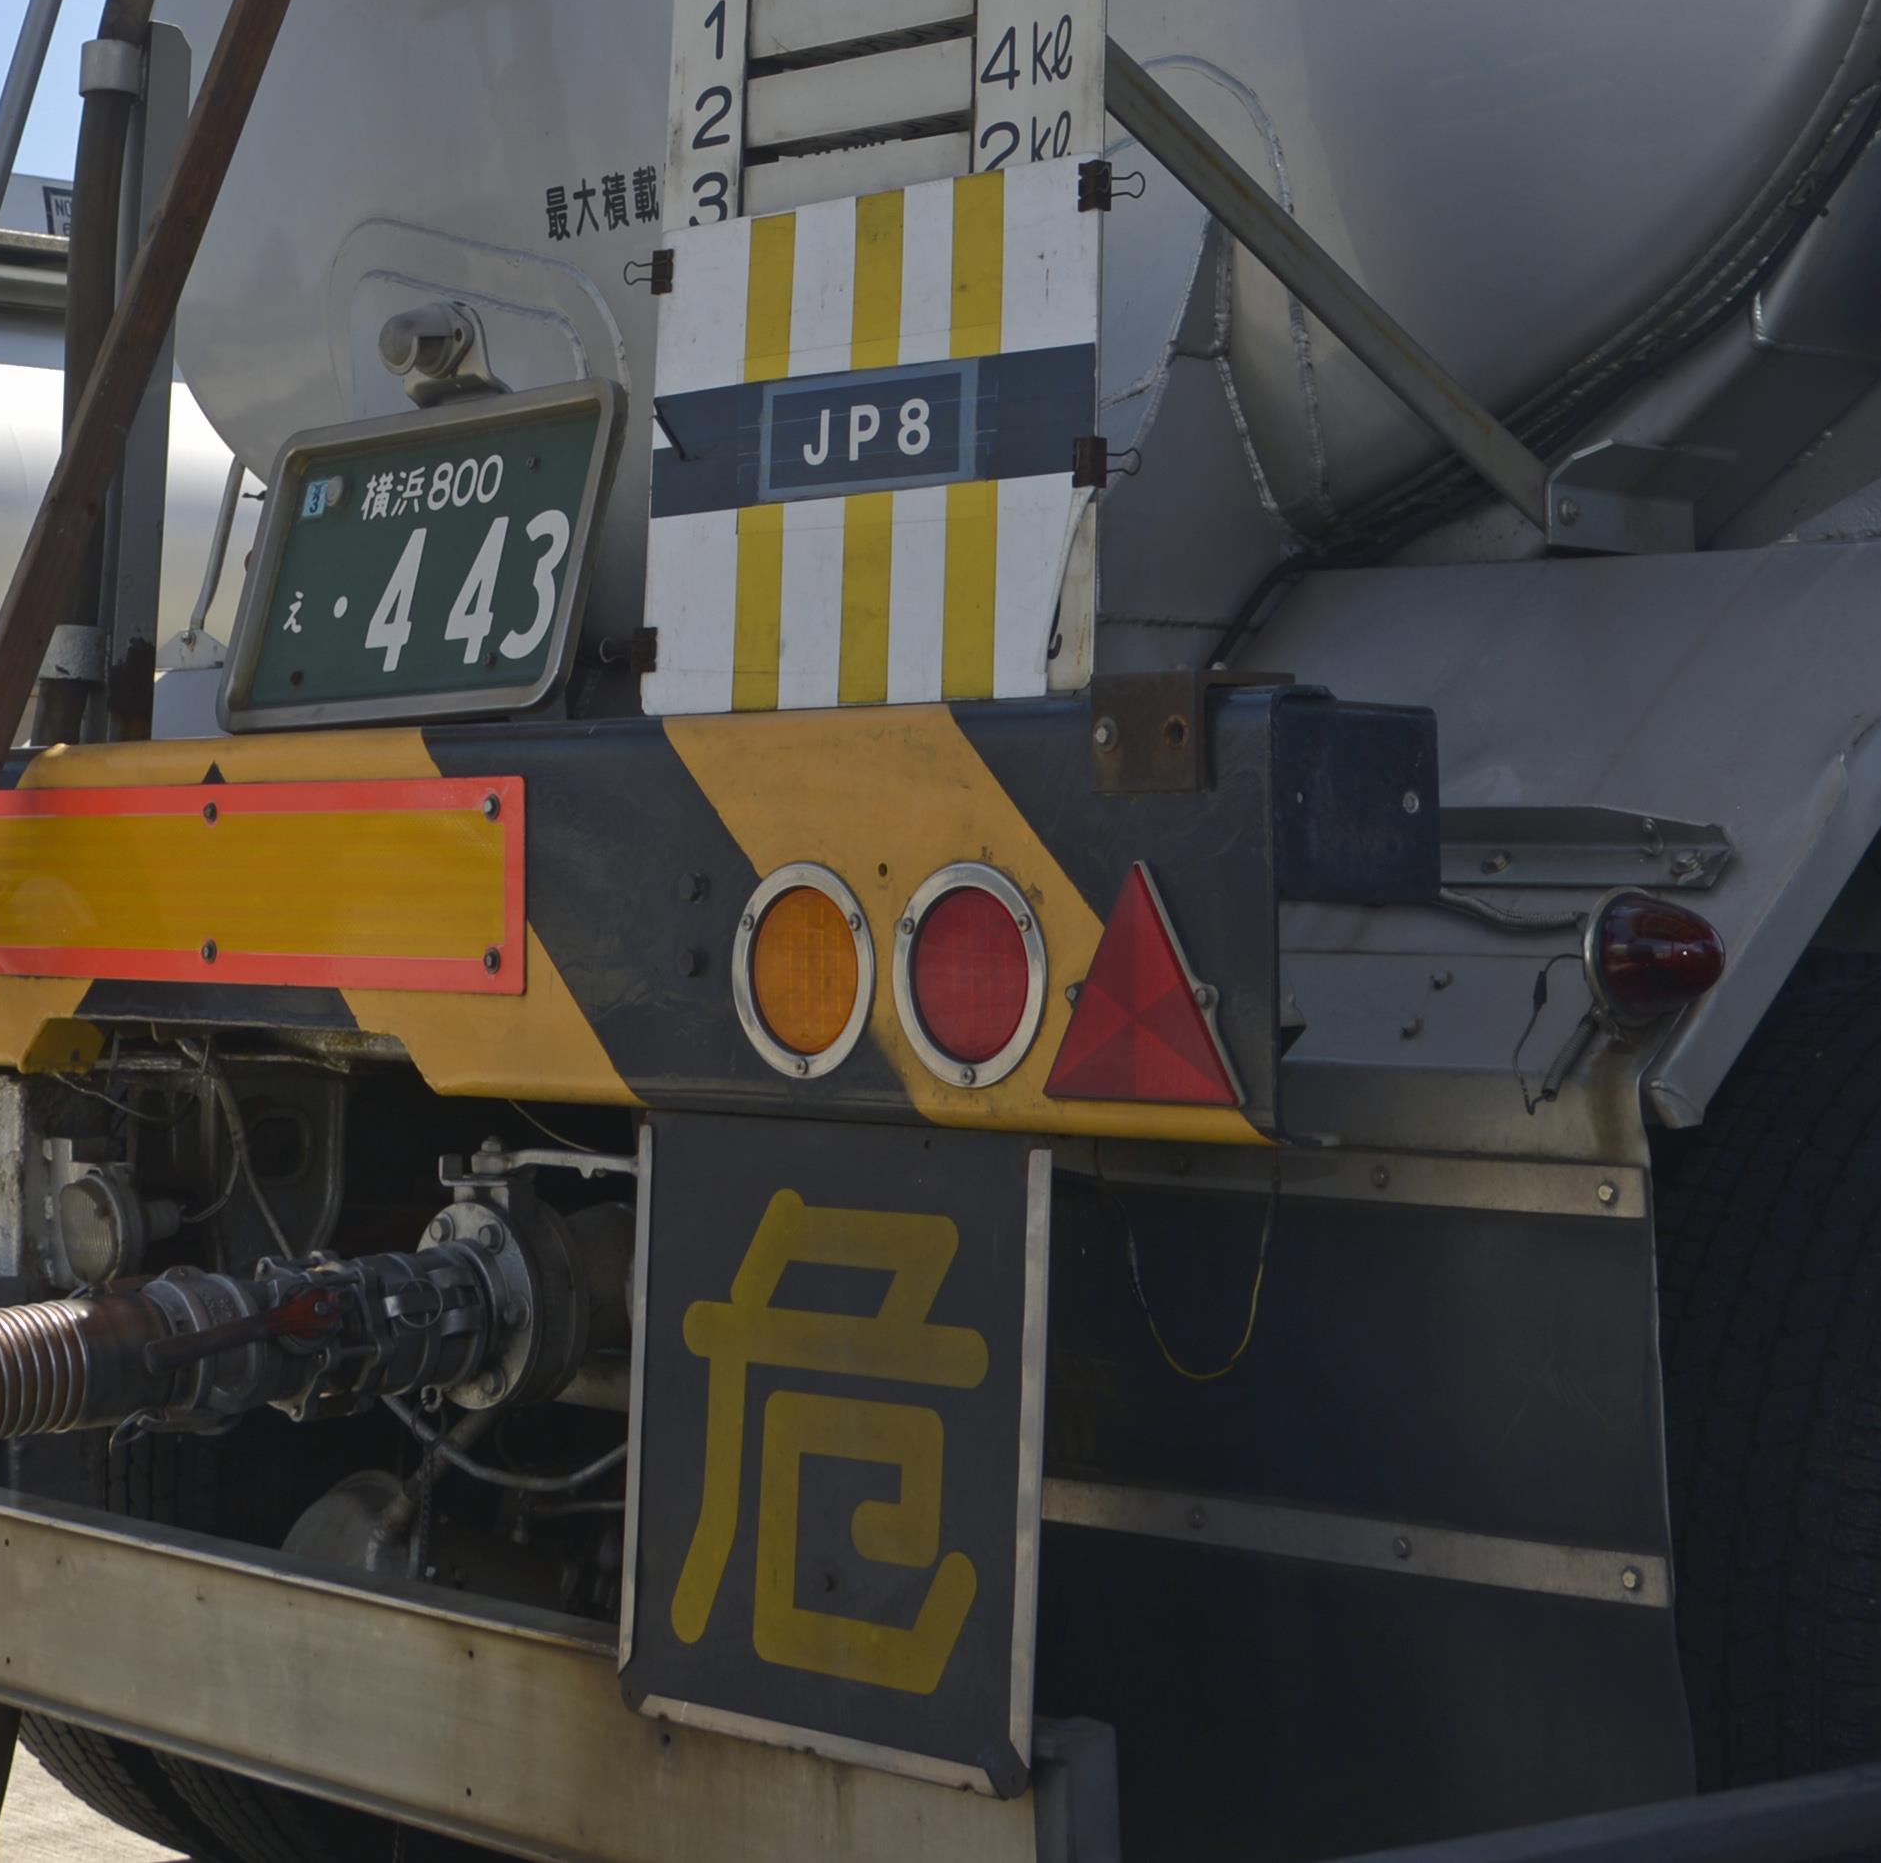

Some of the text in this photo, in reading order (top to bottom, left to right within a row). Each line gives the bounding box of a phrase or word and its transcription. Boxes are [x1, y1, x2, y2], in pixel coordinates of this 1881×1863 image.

[703, 0, 727, 62] 1
[693, 84, 732, 150] 2
[545, 163, 667, 243] 最大積載
[688, 171, 729, 227] 3
[802, 398, 932, 468] JP8
[282, 591, 305, 634] え
[669, 1186, 991, 1696] 危
